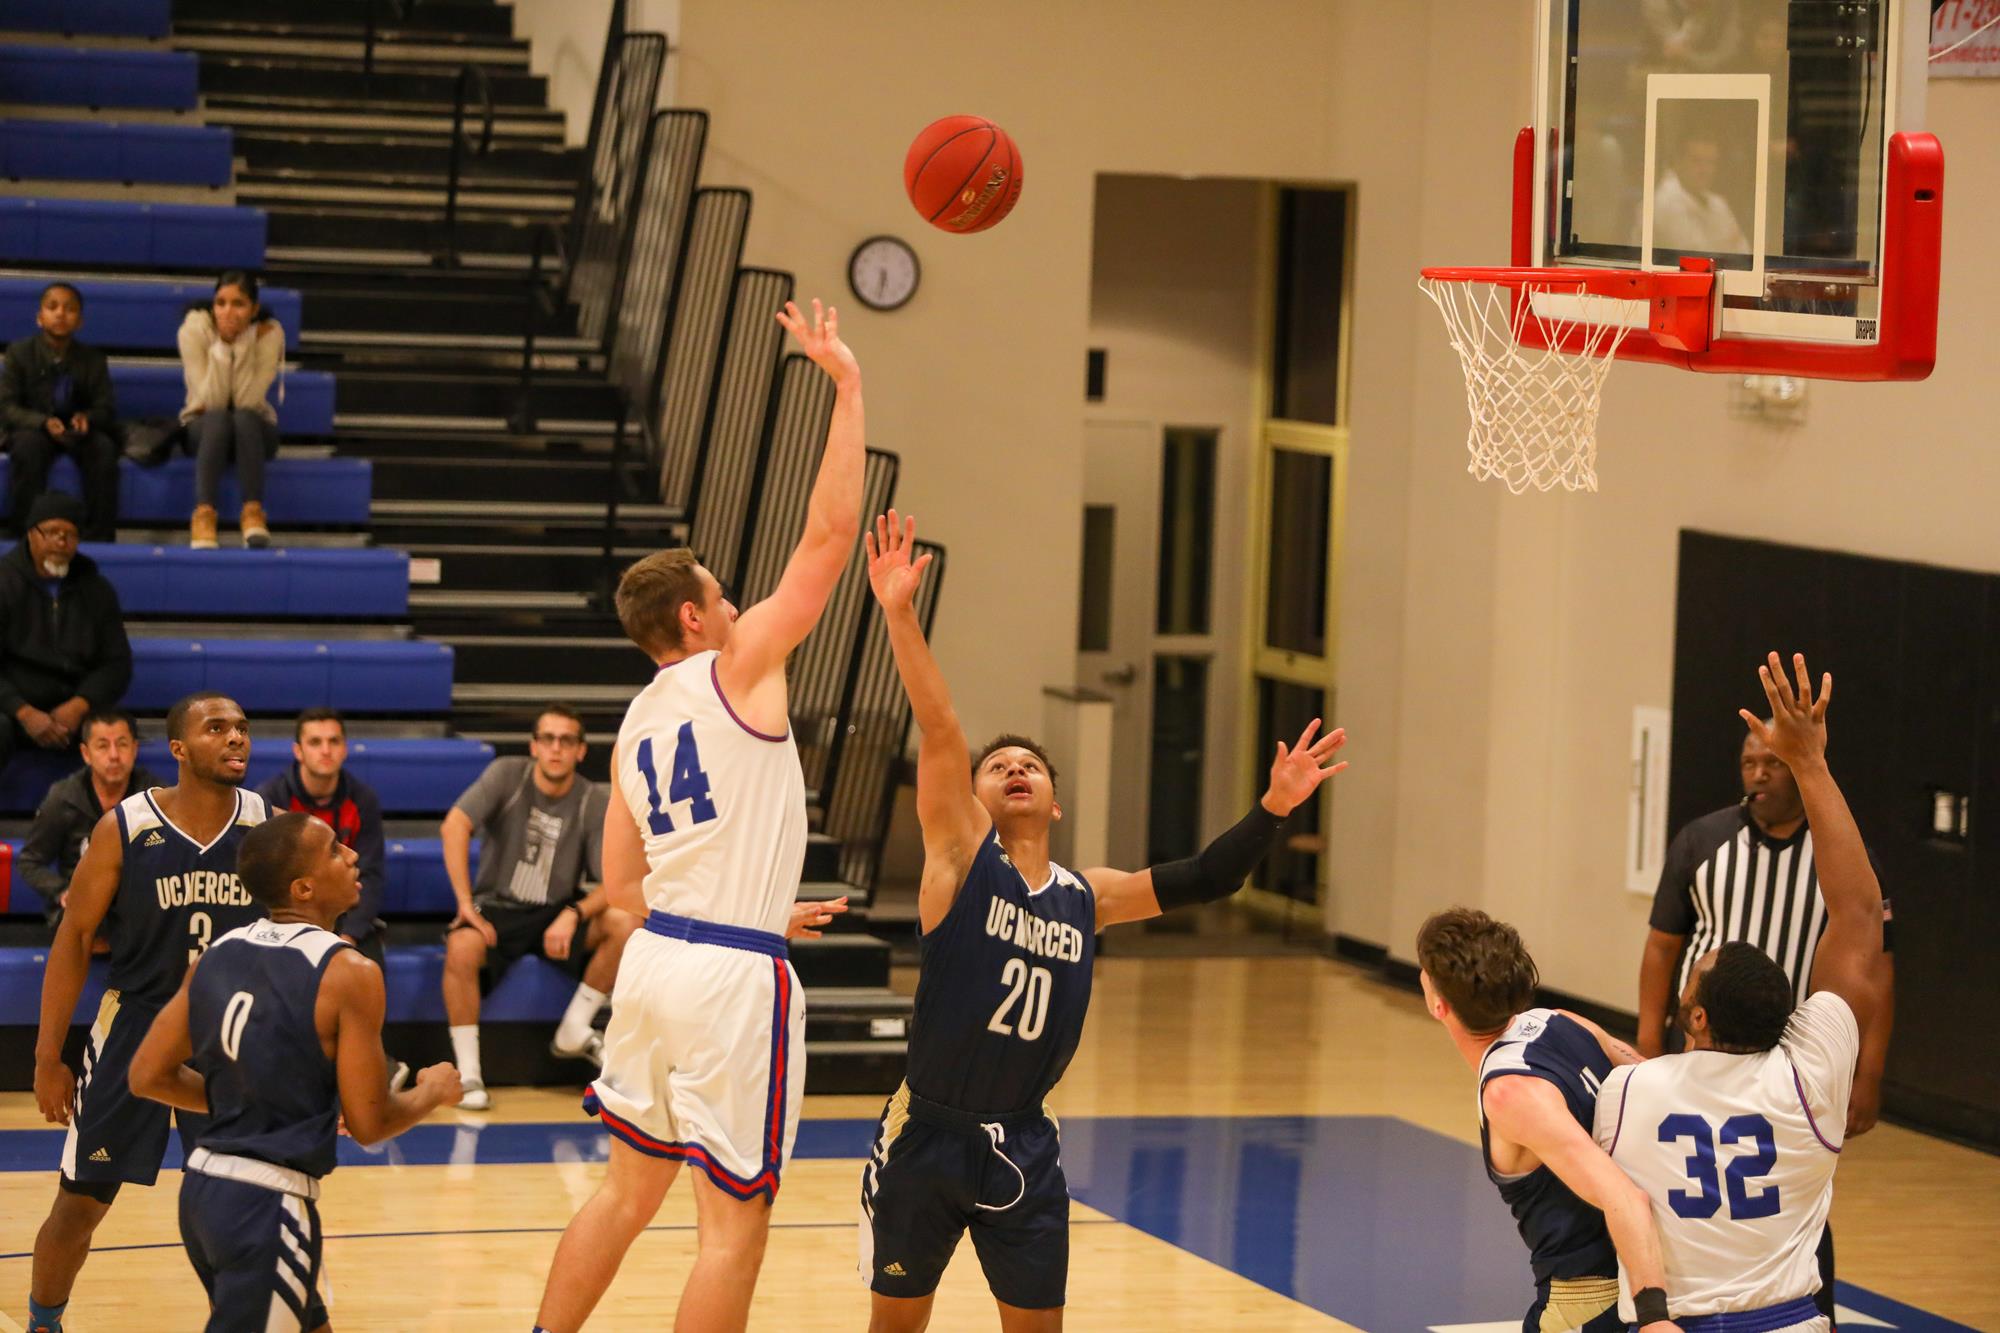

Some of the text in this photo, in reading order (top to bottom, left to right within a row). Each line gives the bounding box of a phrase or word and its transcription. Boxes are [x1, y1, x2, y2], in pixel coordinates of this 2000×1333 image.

[1856, 319, 1877, 340] DRAPER
[637, 720, 718, 836] 14
[156, 875, 184, 910] UC
[985, 895, 1016, 942] UC
[189, 911, 213, 967] 3
[220, 990, 254, 1062] 0
[987, 957, 1053, 1041] 20
[1657, 1112, 1781, 1220] 32
